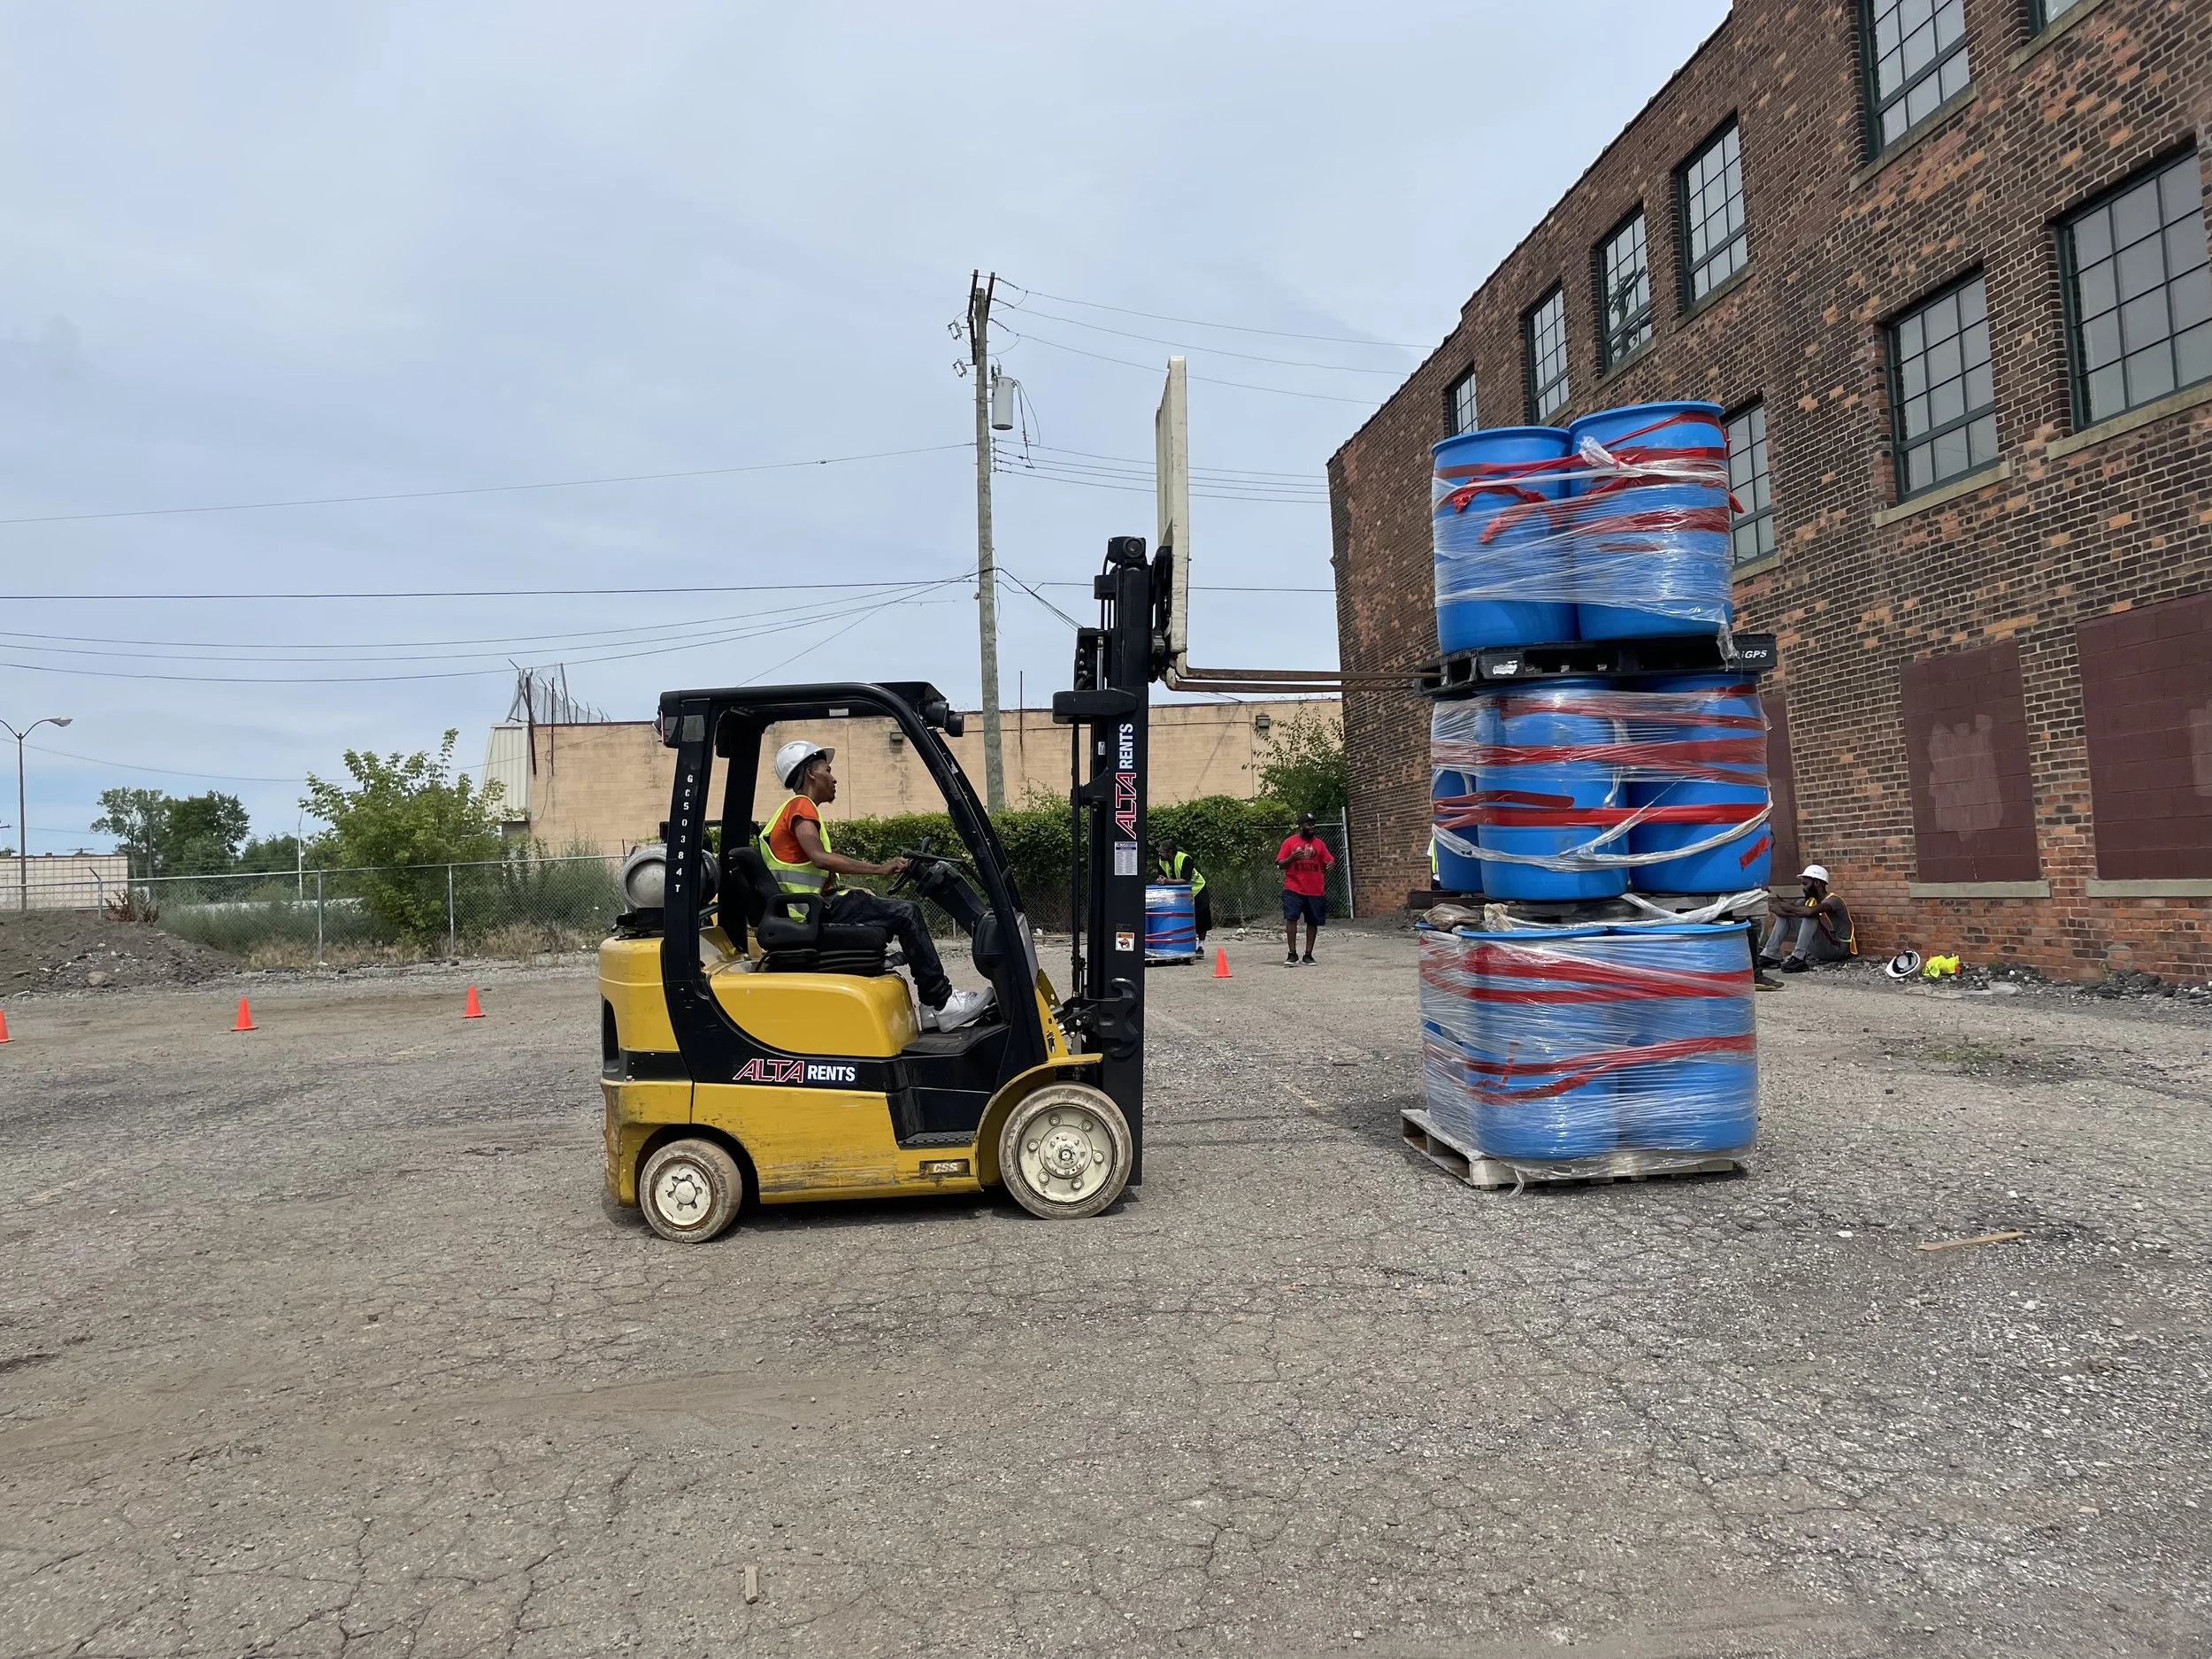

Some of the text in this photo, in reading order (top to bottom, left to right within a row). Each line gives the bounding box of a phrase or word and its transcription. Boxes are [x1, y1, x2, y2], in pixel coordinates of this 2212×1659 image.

[1741, 650, 1768, 659] iGPS
[1119, 723, 1133, 769] RENTS
[1116, 772, 1137, 841] ALTA
[732, 1058, 856, 1083] ALTA RENTS
